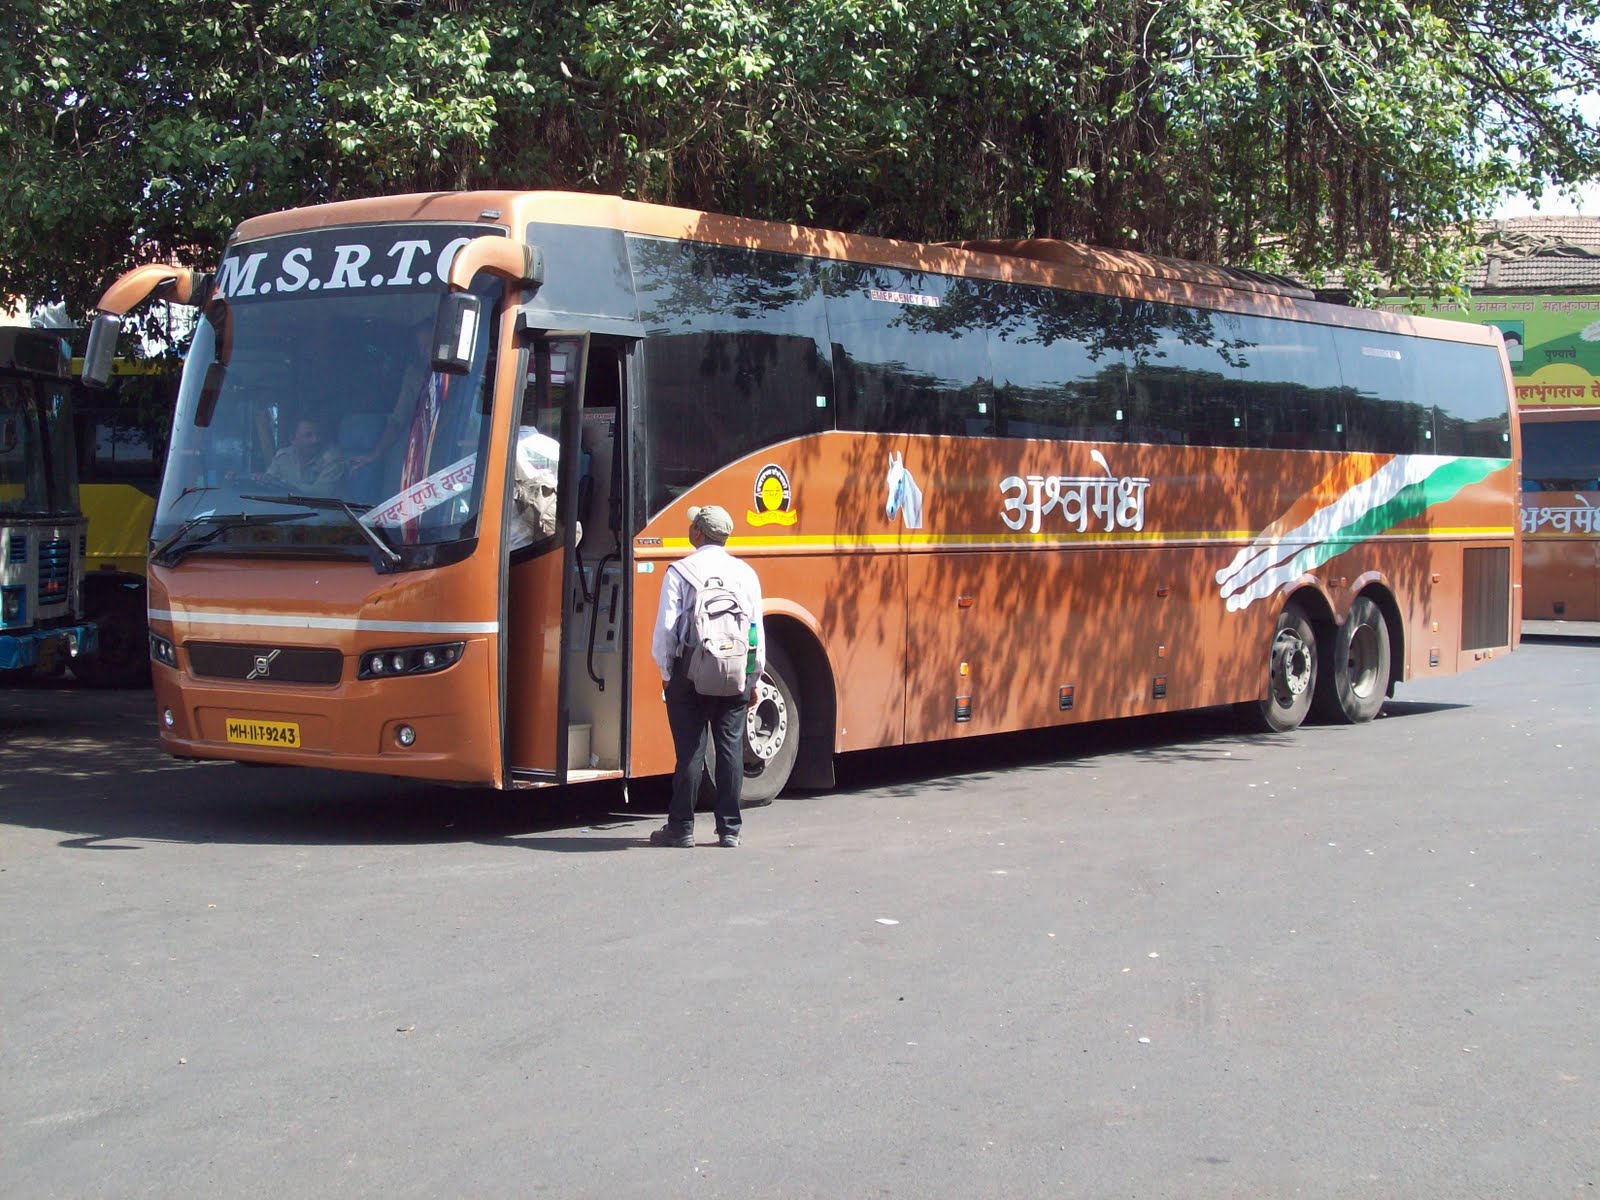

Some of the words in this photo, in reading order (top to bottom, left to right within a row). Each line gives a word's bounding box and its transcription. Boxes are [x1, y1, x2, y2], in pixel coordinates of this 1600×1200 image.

[871, 291, 919, 304] EMERGENCY
[1544, 346, 1577, 362] पुण्याचे
[408, 482, 438, 511] पुणे
[440, 463, 475, 491] दादर
[1000, 449, 1151, 533] अश्वमेध
[1521, 494, 1600, 534] अश्वमे
